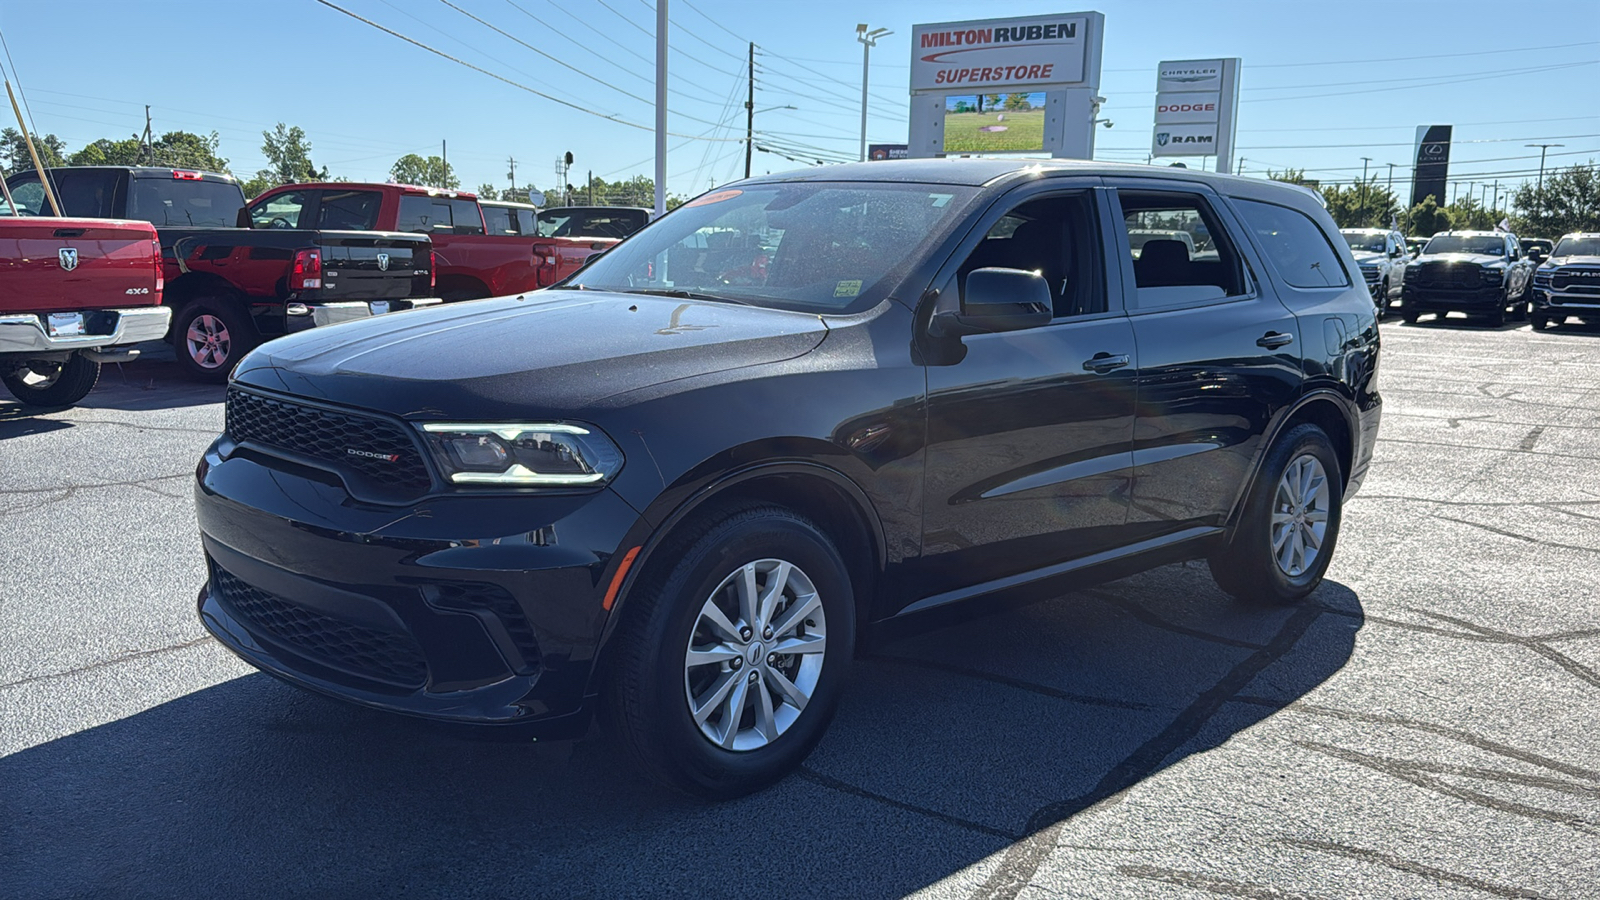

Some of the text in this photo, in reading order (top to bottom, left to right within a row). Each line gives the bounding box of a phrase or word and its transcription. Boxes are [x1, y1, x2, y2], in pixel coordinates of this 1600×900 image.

[921, 23, 1076, 48] MILTON RUBEN
[935, 64, 1053, 84] SUPERSTORE
[1158, 104, 1215, 113] DODGE
[125, 287, 149, 295] 4X4
[347, 448, 392, 461] DODGE
